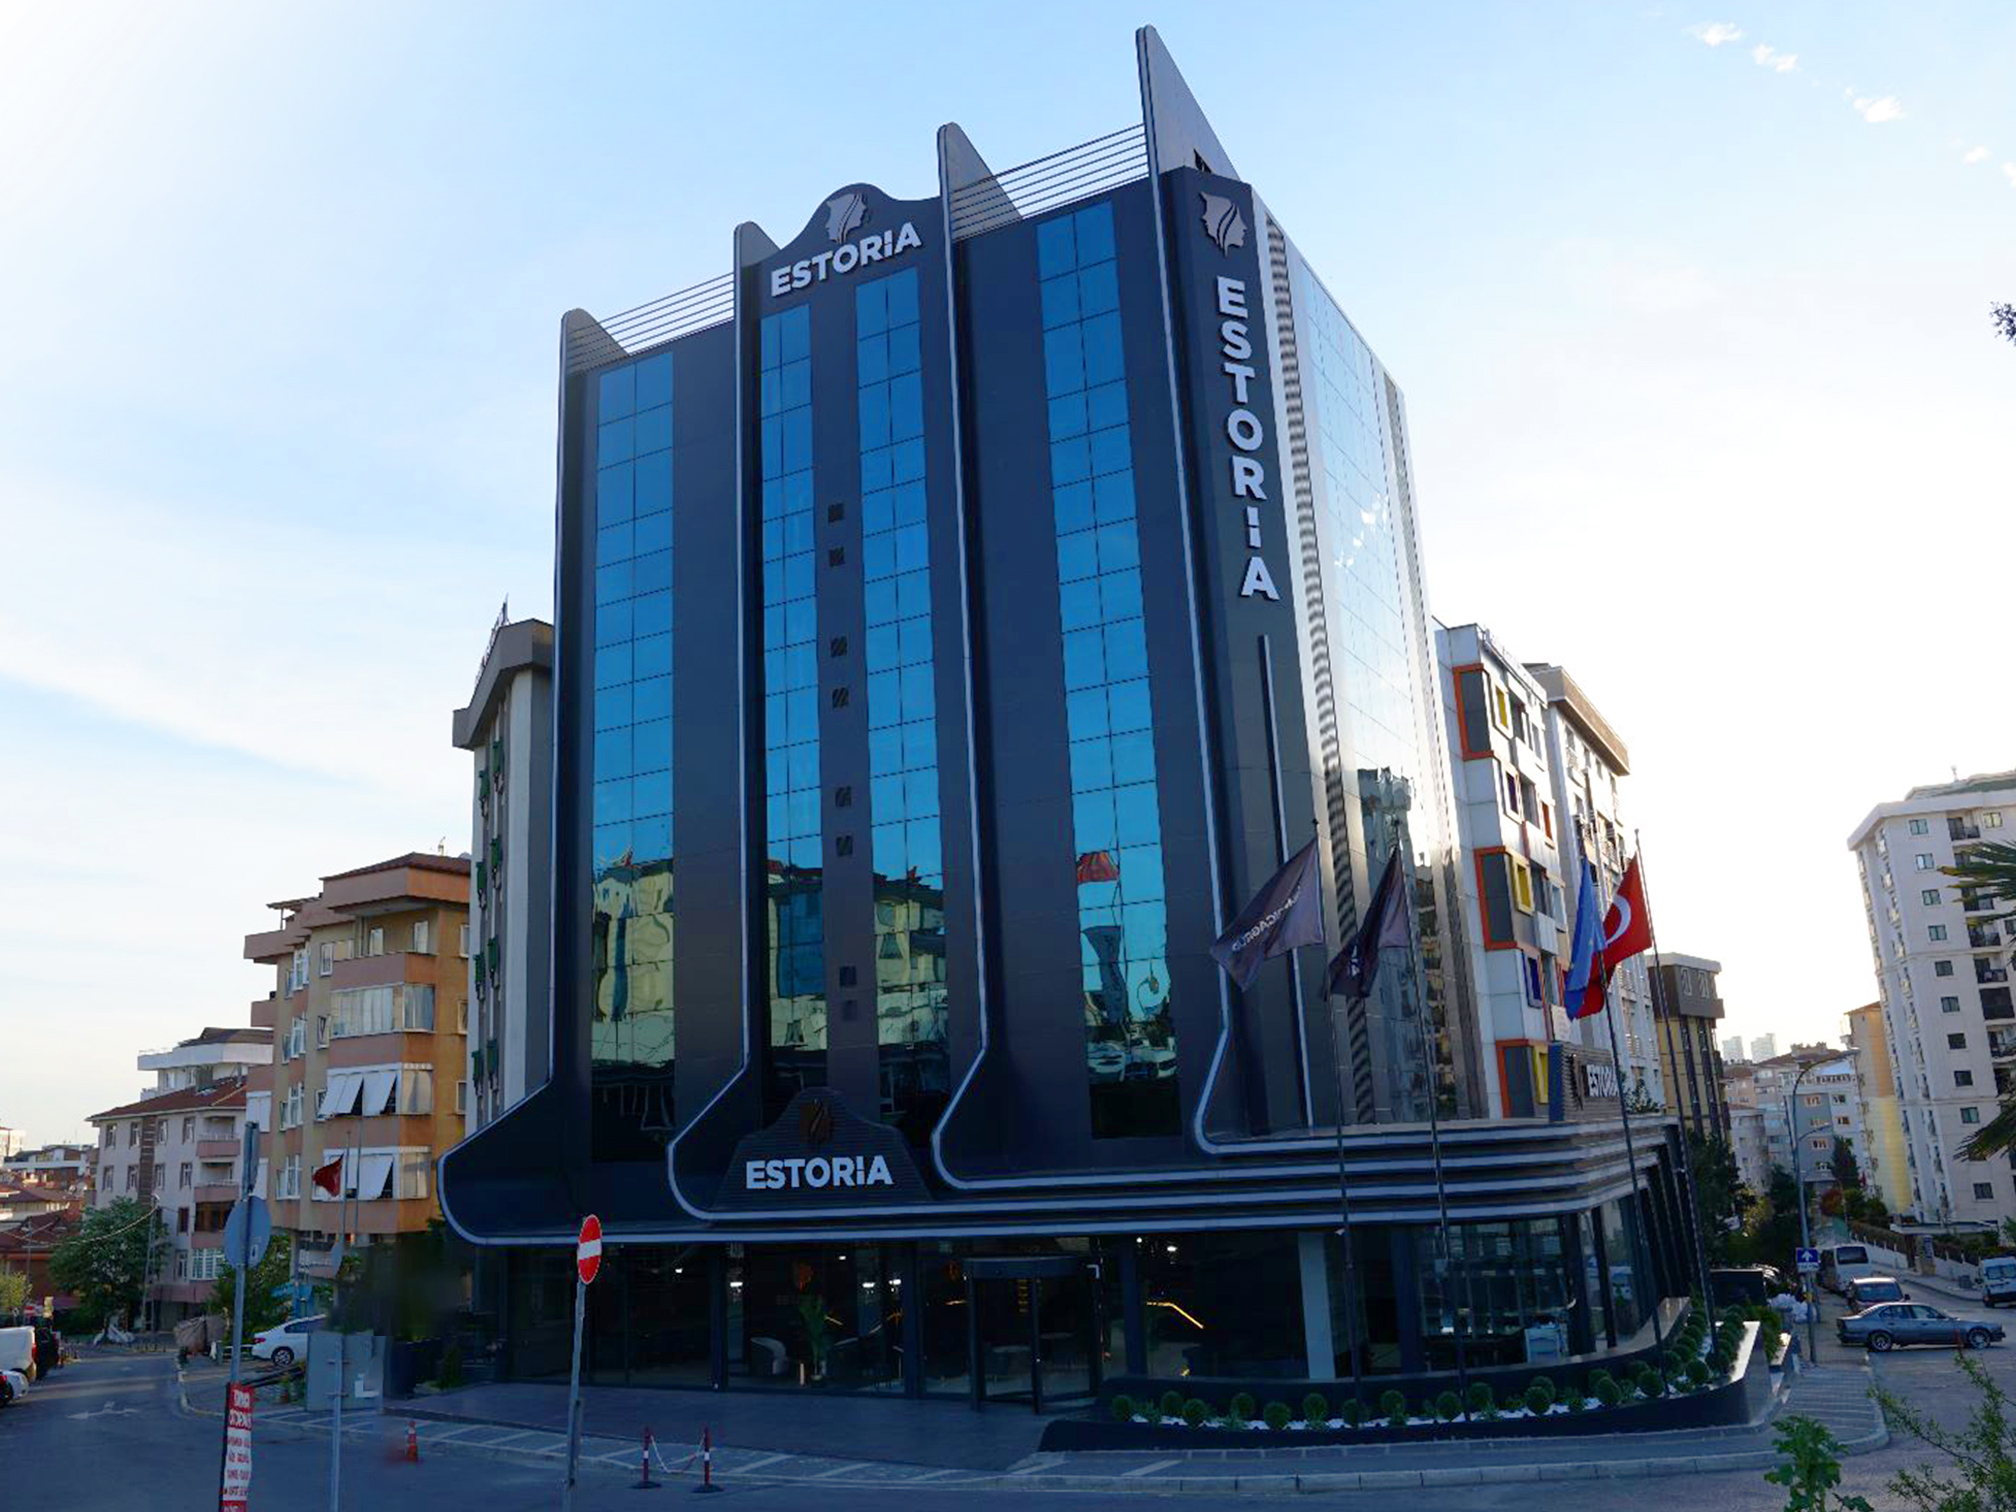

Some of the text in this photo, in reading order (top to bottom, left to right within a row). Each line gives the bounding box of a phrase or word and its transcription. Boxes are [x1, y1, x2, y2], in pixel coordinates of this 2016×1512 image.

[770, 221, 922, 297] ESTORIA
[1216, 275, 1281, 600] ESTORIA
[745, 1154, 894, 1190] ESTORIA
